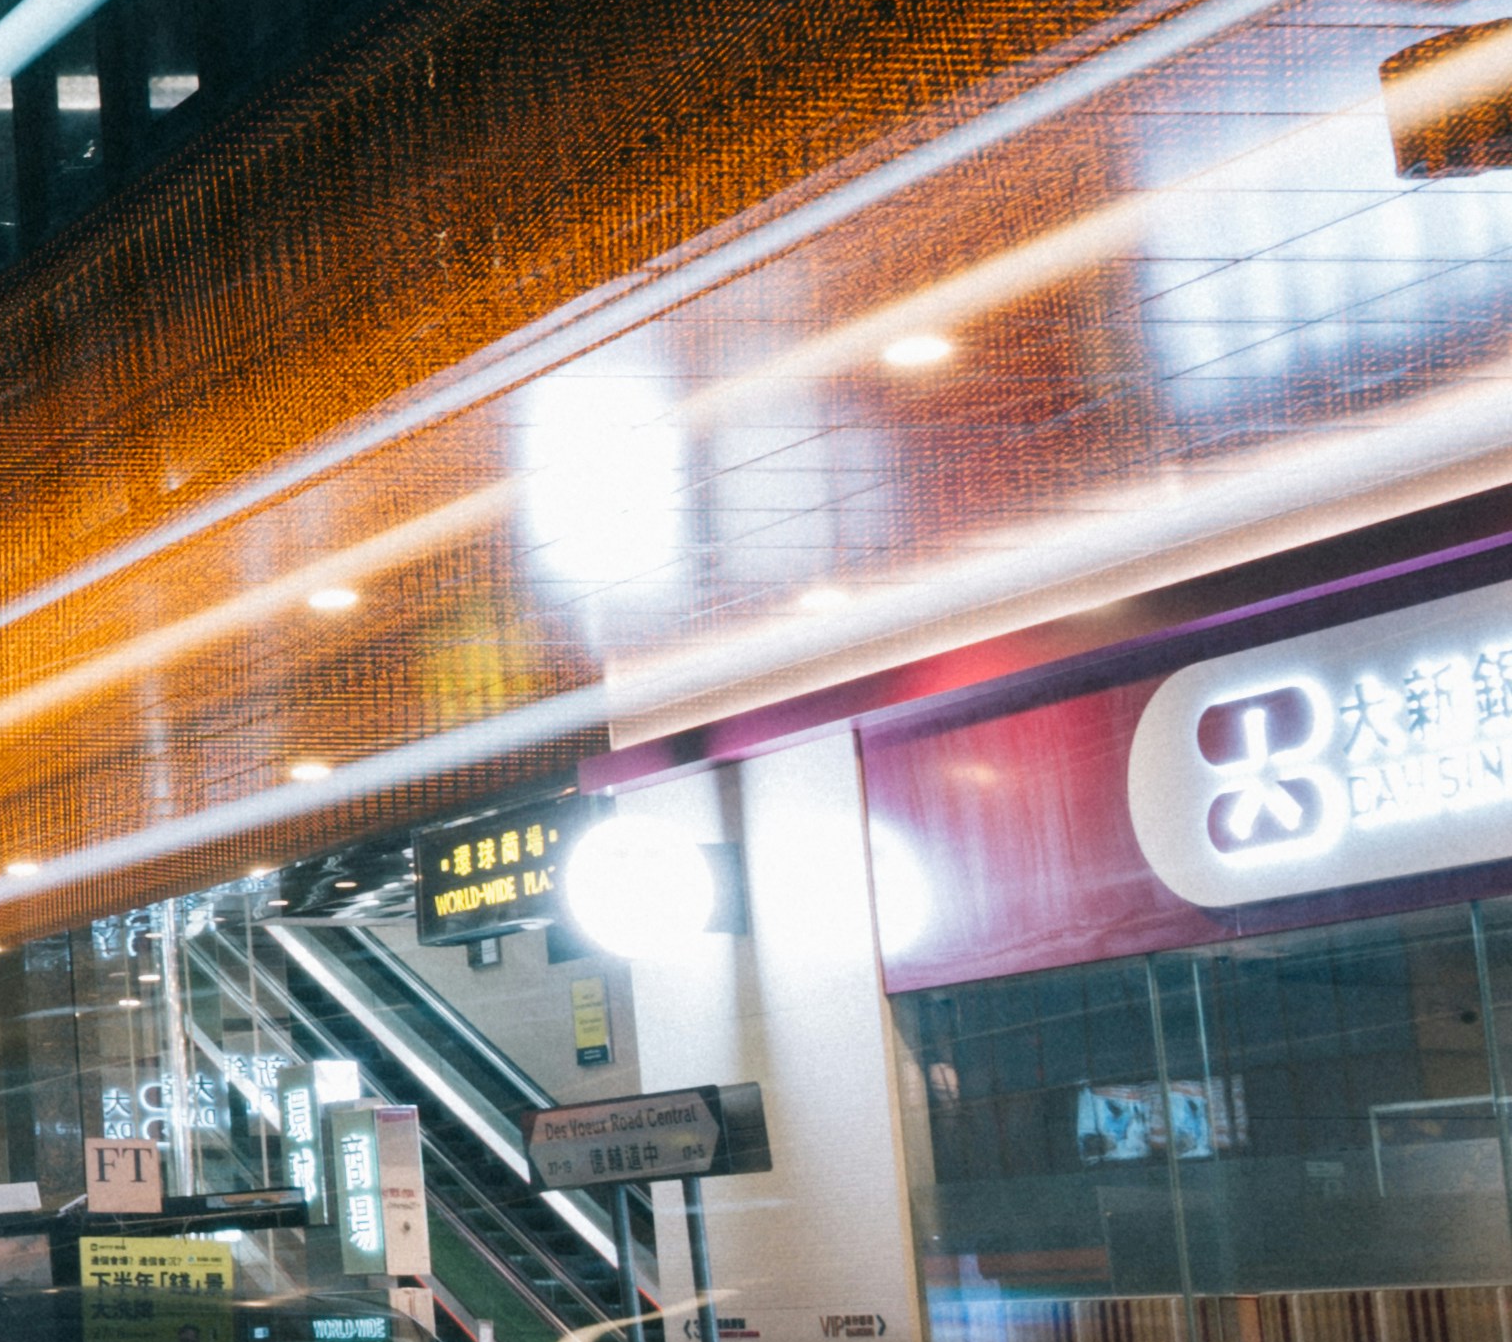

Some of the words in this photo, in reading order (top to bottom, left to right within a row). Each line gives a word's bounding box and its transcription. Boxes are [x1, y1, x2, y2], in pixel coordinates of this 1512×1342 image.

[1348, 762, 1426, 817] DAH
[453, 824, 545, 877] 環球商場
[434, 875, 518, 917] WORLD-WIDE
[544, 1120, 568, 1141] Des
[569, 1116, 608, 1139] Voeux
[609, 1111, 644, 1133] Road
[646, 1104, 698, 1128] Central
[93, 1147, 152, 1183] FT
[588, 1140, 660, 1175] 德輔道中
[312, 1316, 387, 1340] WORLD-WIDE
[819, 1315, 845, 1338] VIP
